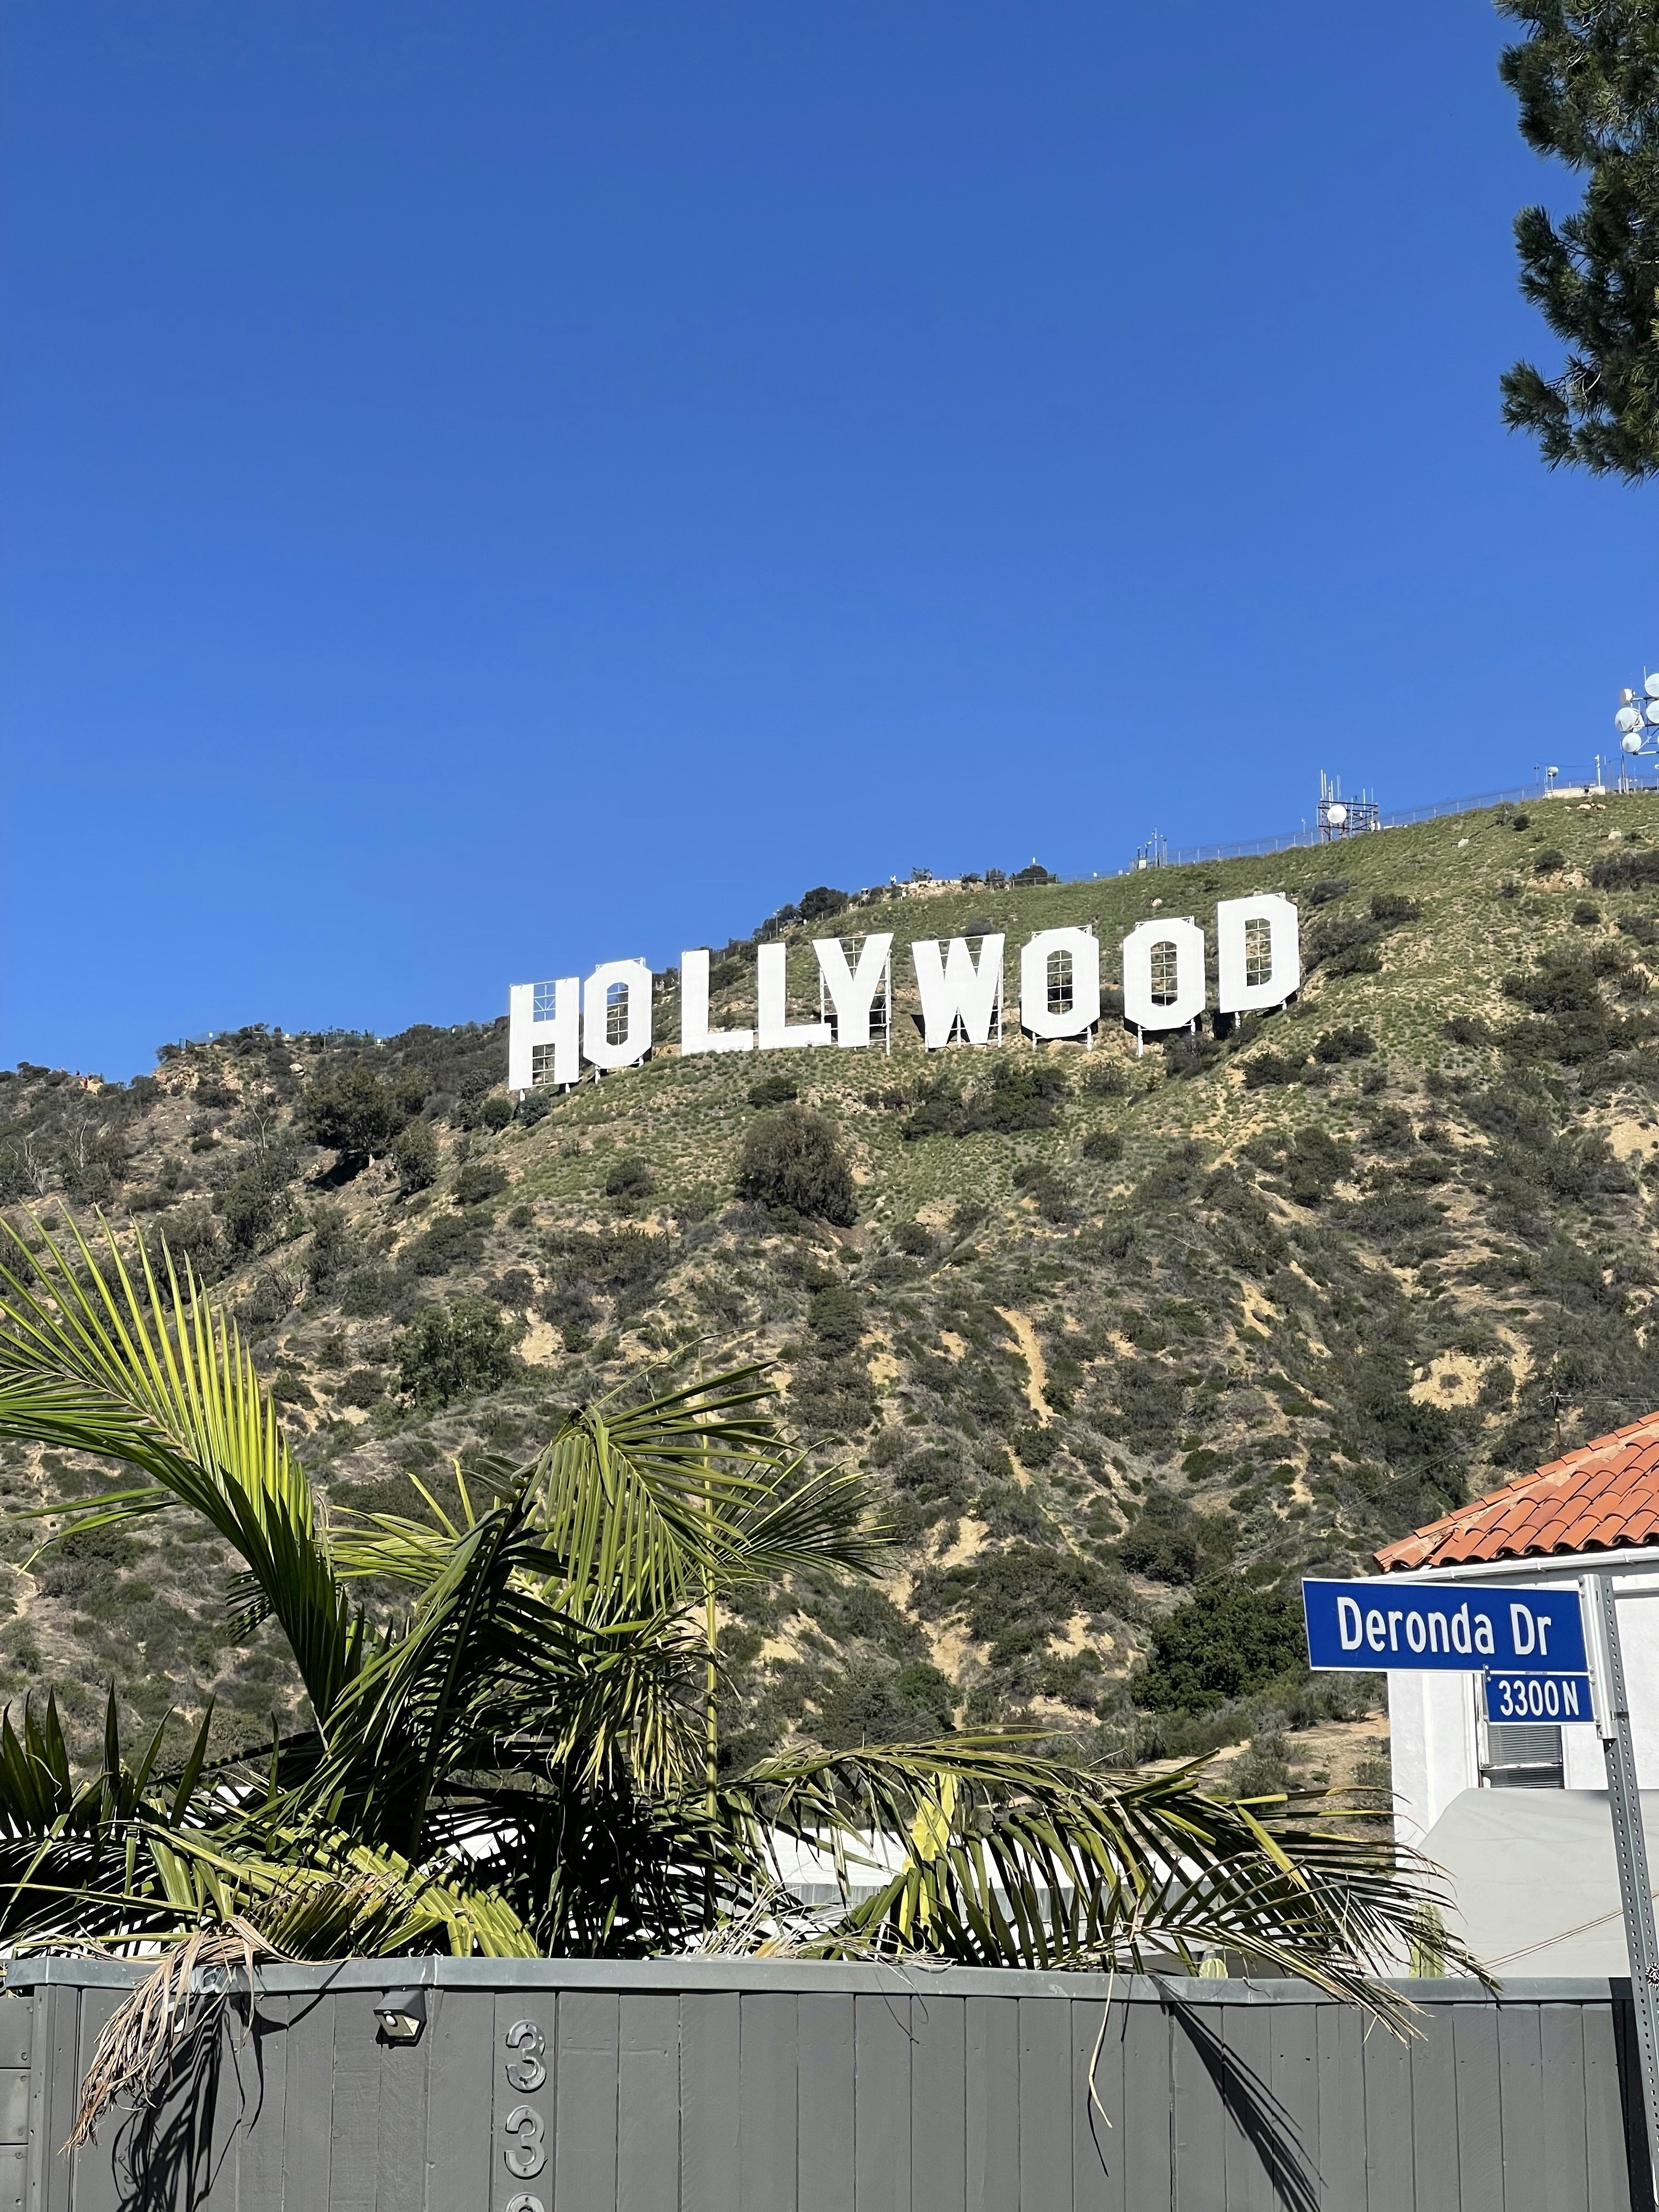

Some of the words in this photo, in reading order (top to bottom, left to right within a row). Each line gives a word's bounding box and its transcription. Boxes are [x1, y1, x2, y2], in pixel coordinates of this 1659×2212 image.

[509, 892, 1300, 1091] HOLLYWOOD
[1337, 1596, 1495, 1654] Deronda
[1510, 1603, 1551, 1656] Dr
[1499, 1680, 1559, 1716] 3300
[1562, 1680, 1579, 1716] N
[505, 2019, 547, 2212] 33
